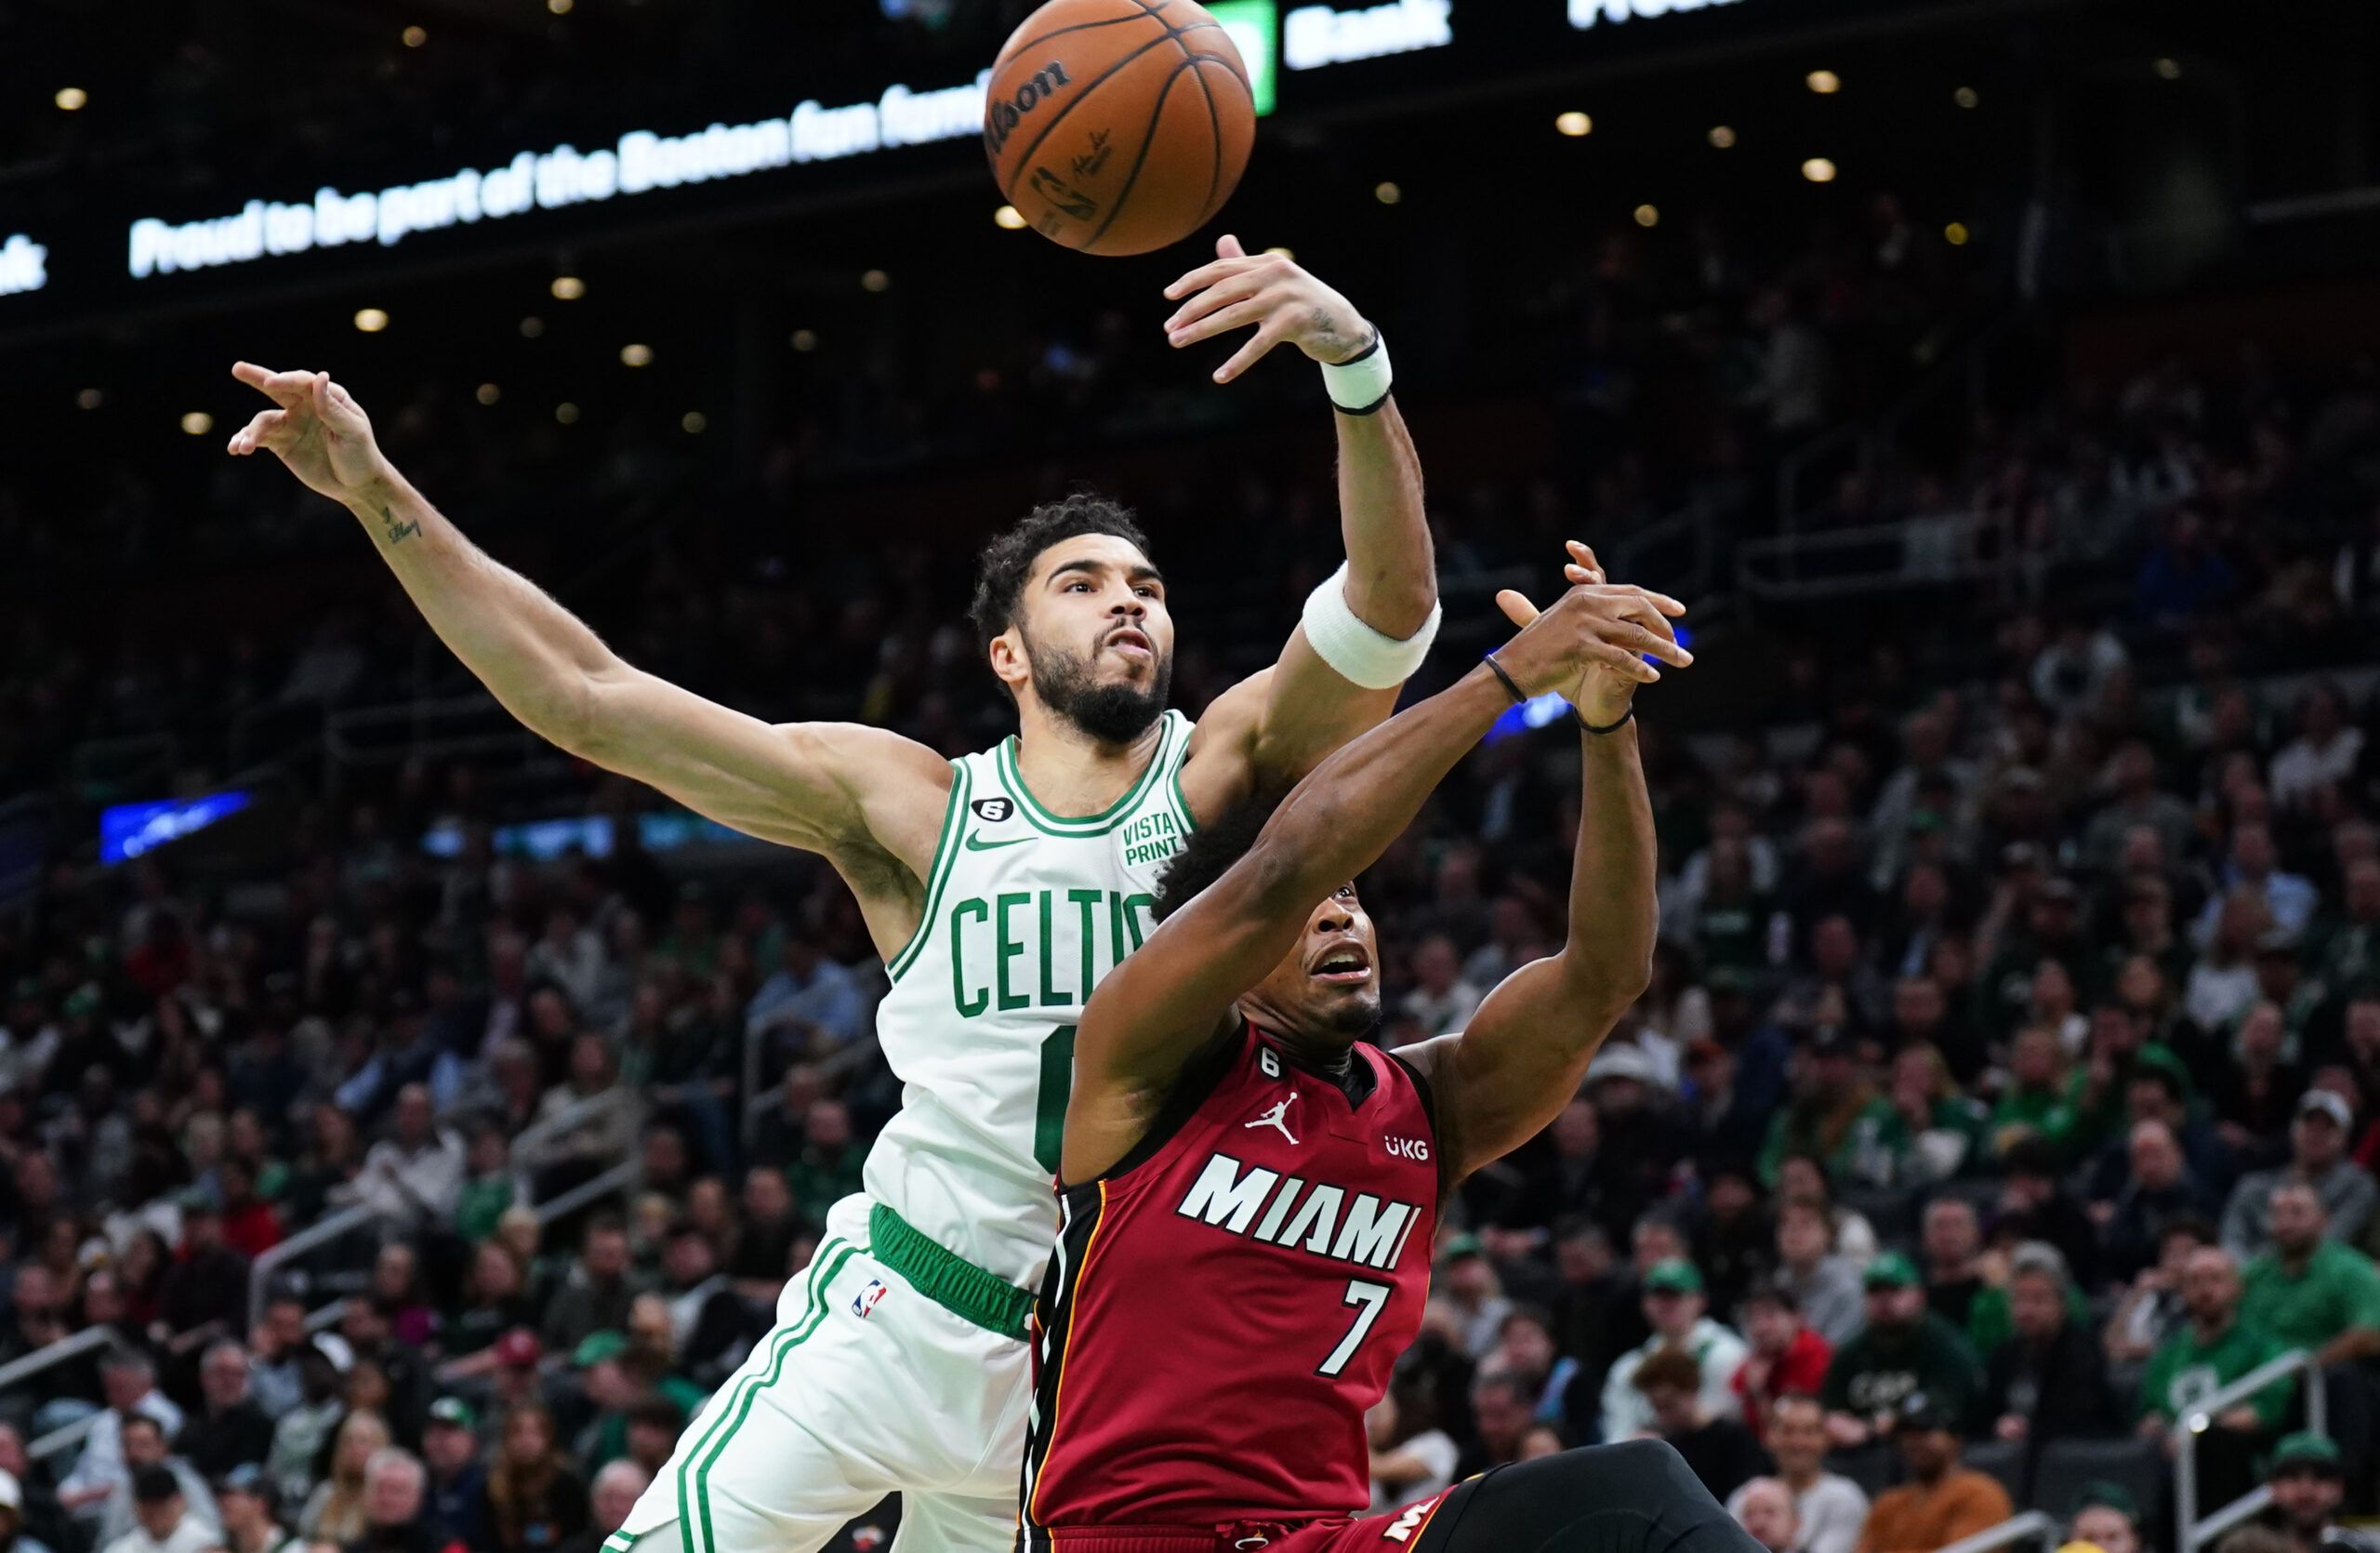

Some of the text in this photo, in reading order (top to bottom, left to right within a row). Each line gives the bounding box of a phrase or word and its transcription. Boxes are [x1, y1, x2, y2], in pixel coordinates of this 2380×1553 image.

[131, 201, 264, 276] Proud
[265, 203, 314, 255] to
[377, 169, 481, 245] part
[979, 800, 1006, 821] 6
[1123, 812, 1176, 846] VISTA
[1125, 836, 1183, 866] PRINT
[1261, 1046, 1280, 1078] 6
[1316, 1279, 1392, 1375] 7
